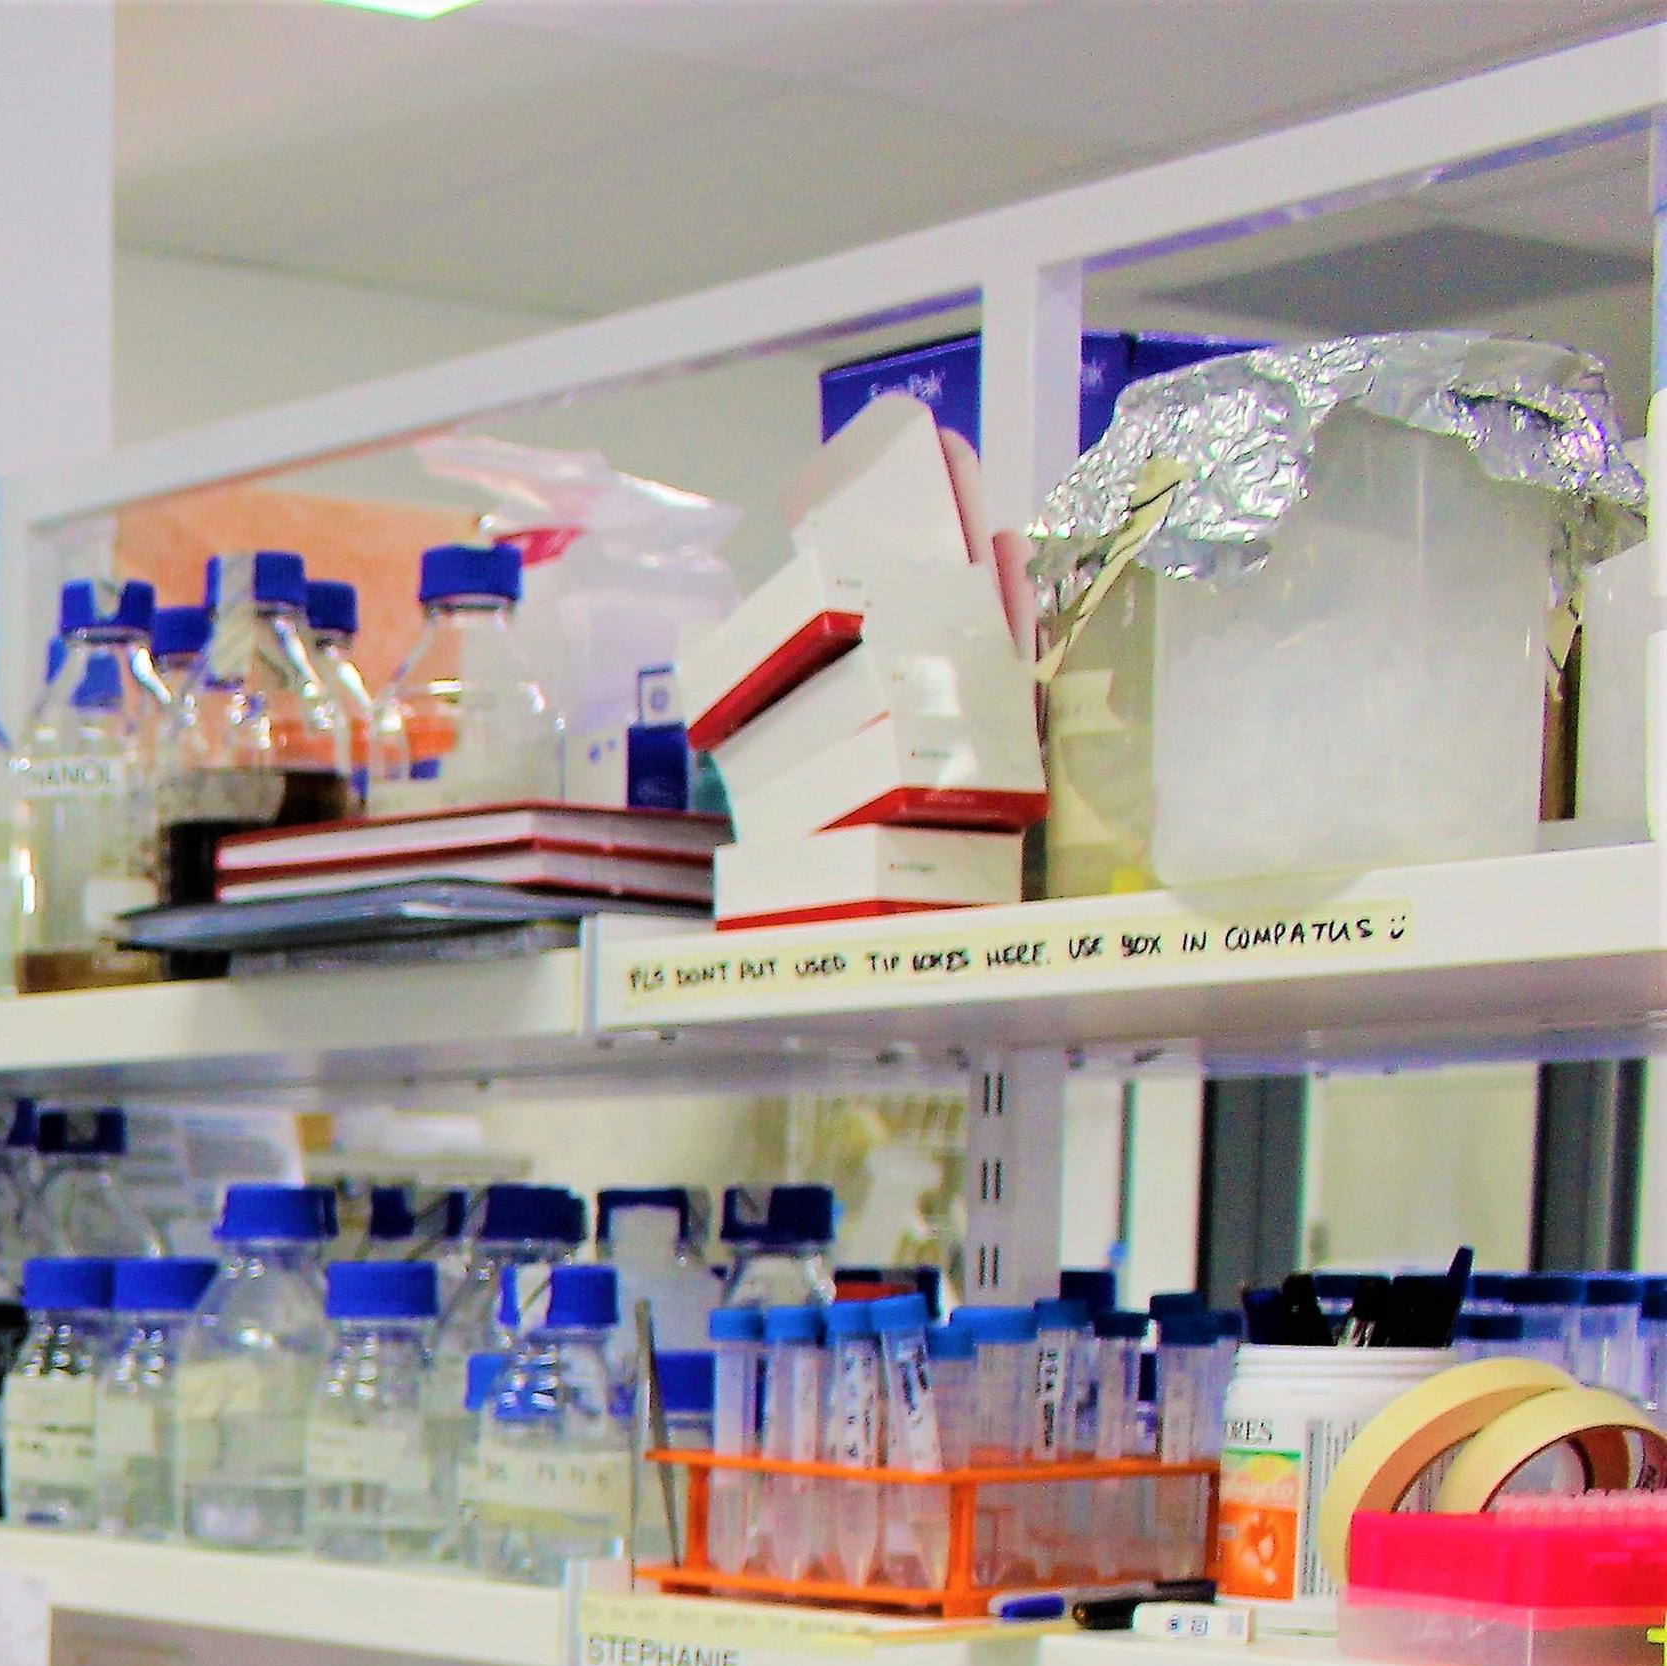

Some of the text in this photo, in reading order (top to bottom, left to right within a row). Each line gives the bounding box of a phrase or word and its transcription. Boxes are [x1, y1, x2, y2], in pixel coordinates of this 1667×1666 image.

[628, 967, 665, 992] PLS
[794, 954, 846, 978] USED
[866, 951, 900, 974] TIP
[1068, 936, 1103, 960] USE
[1183, 931, 1207, 952] IN
[1224, 917, 1373, 951] COMPATUS
